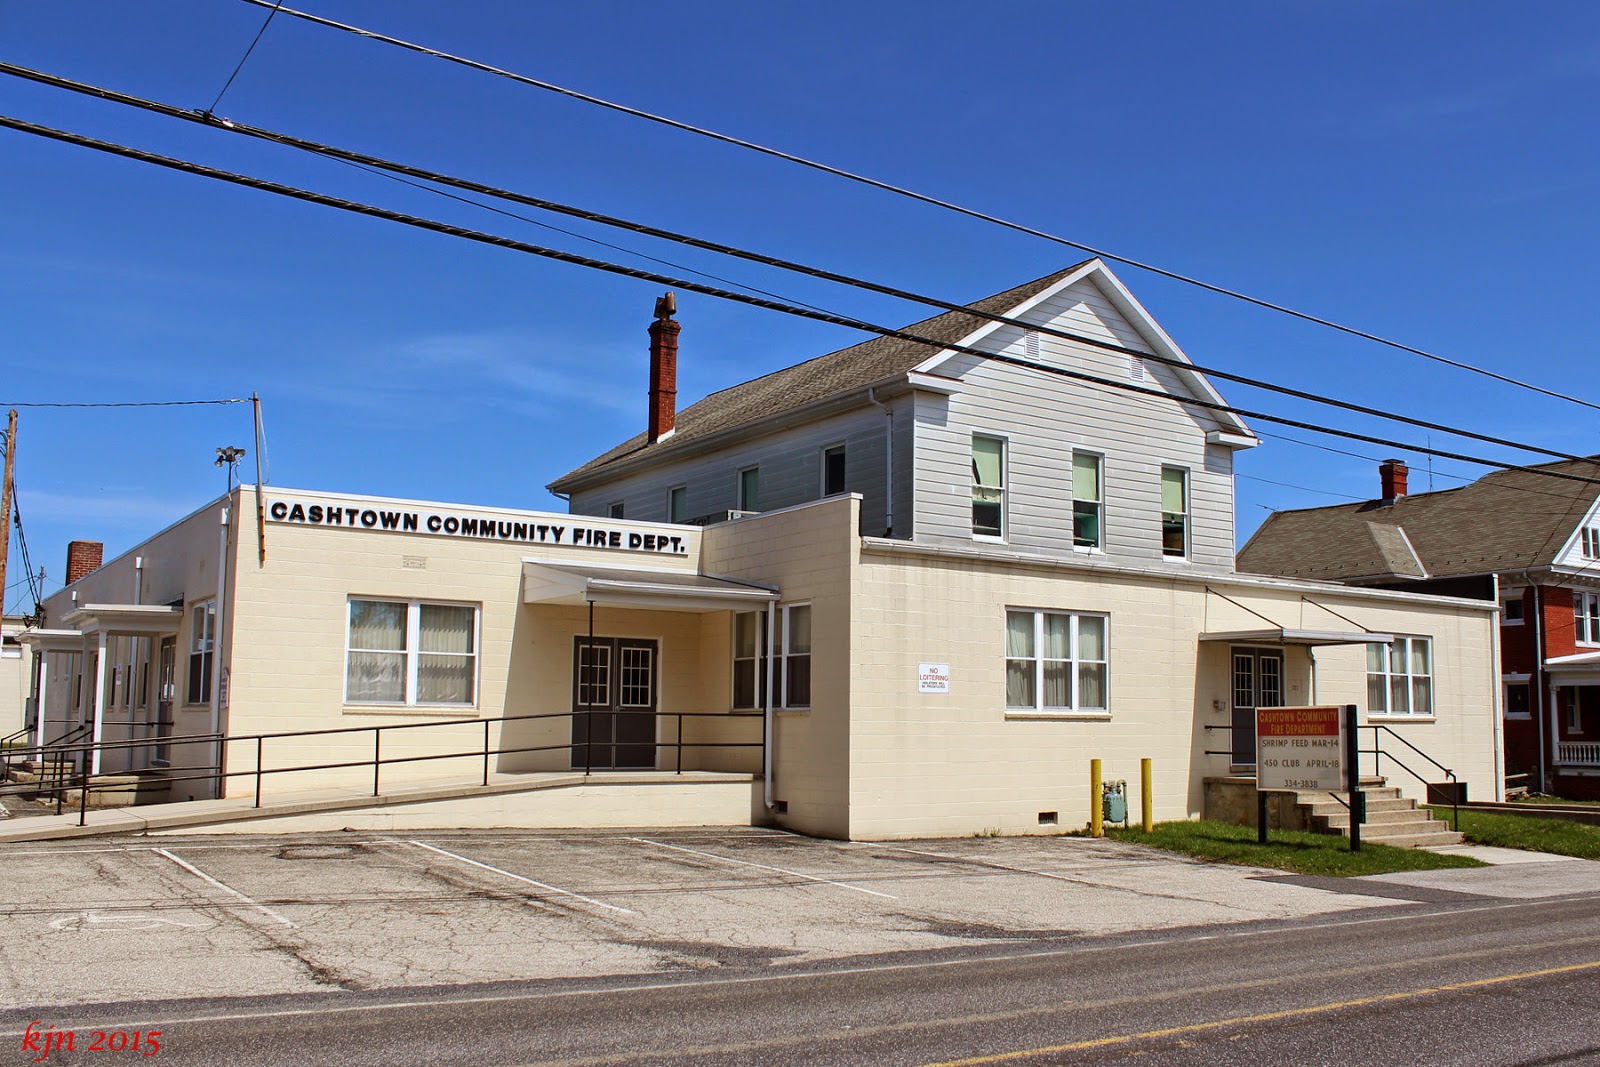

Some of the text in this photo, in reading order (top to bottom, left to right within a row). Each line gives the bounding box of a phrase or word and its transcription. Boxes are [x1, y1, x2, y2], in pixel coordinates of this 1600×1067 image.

[271, 502, 685, 553] CASHTOWN COMMUNITY FIRE DEPT.
[1260, 711, 1338, 723] CASHTOWN COMMUNITY
[1271, 724, 1326, 735] FIRE DEPARTMENT
[1262, 739, 1339, 748] SHRIMP FEED MAR-14
[1264, 759, 1340, 768] 450 CLUB APRIL-18
[1284, 779, 1318, 788] 334-3838
